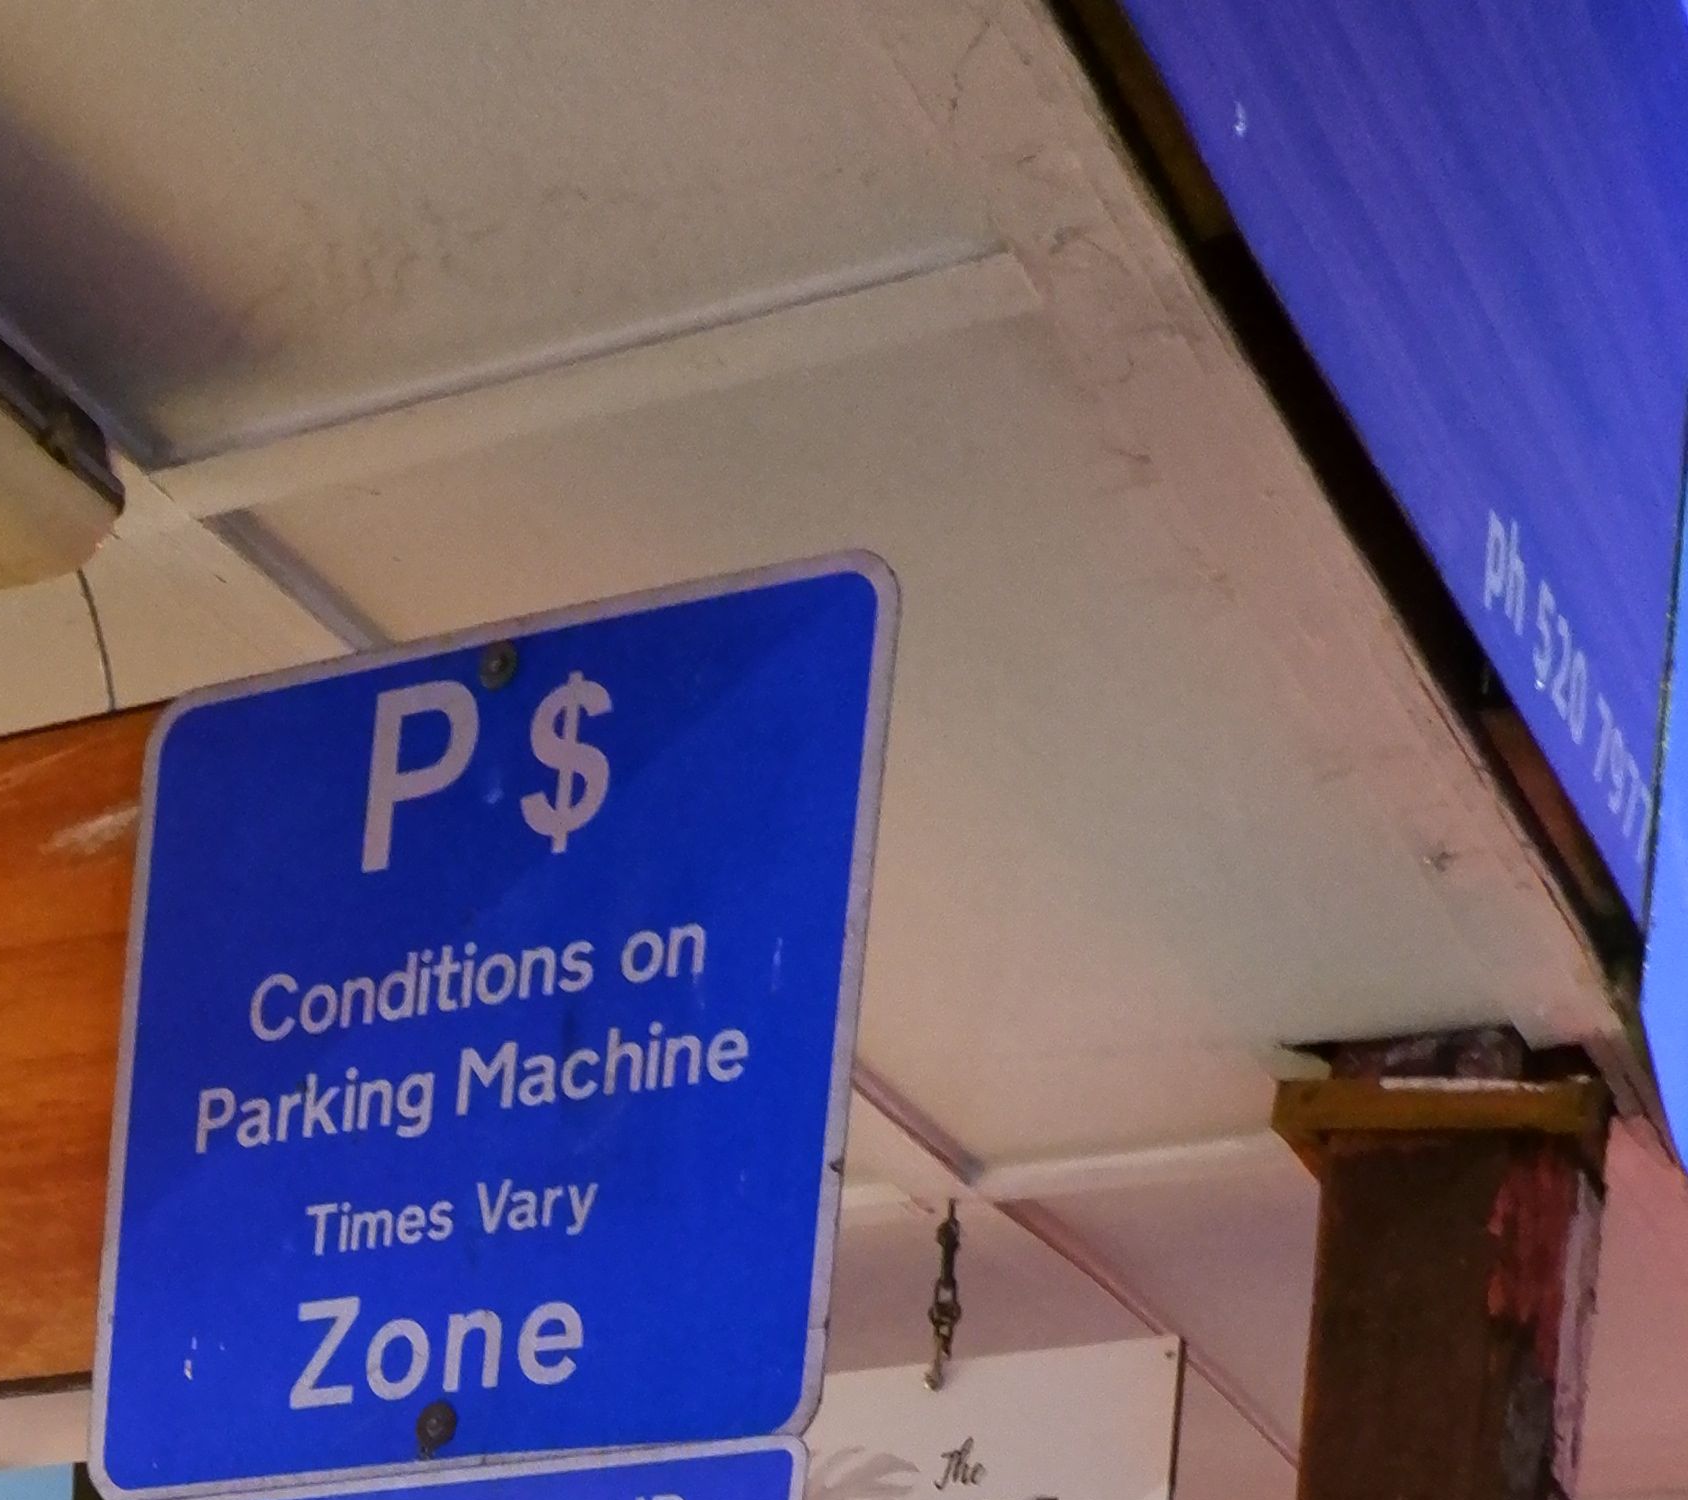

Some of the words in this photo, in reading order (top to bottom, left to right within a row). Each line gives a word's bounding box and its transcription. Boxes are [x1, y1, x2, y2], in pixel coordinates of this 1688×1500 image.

[1484, 508, 1527, 637] ph
[1533, 578, 1588, 746] 520
[361, 679, 480, 874] P
[520, 670, 613, 854] $
[249, 939, 595, 1043] Conditions
[620, 922, 707, 984] on
[195, 1069, 434, 1154] Parking
[455, 1022, 750, 1117] Machine
[306, 1197, 454, 1258] Times
[474, 1177, 600, 1237] Vary
[288, 1296, 586, 1410] Zone
[933, 1436, 987, 1490] The
